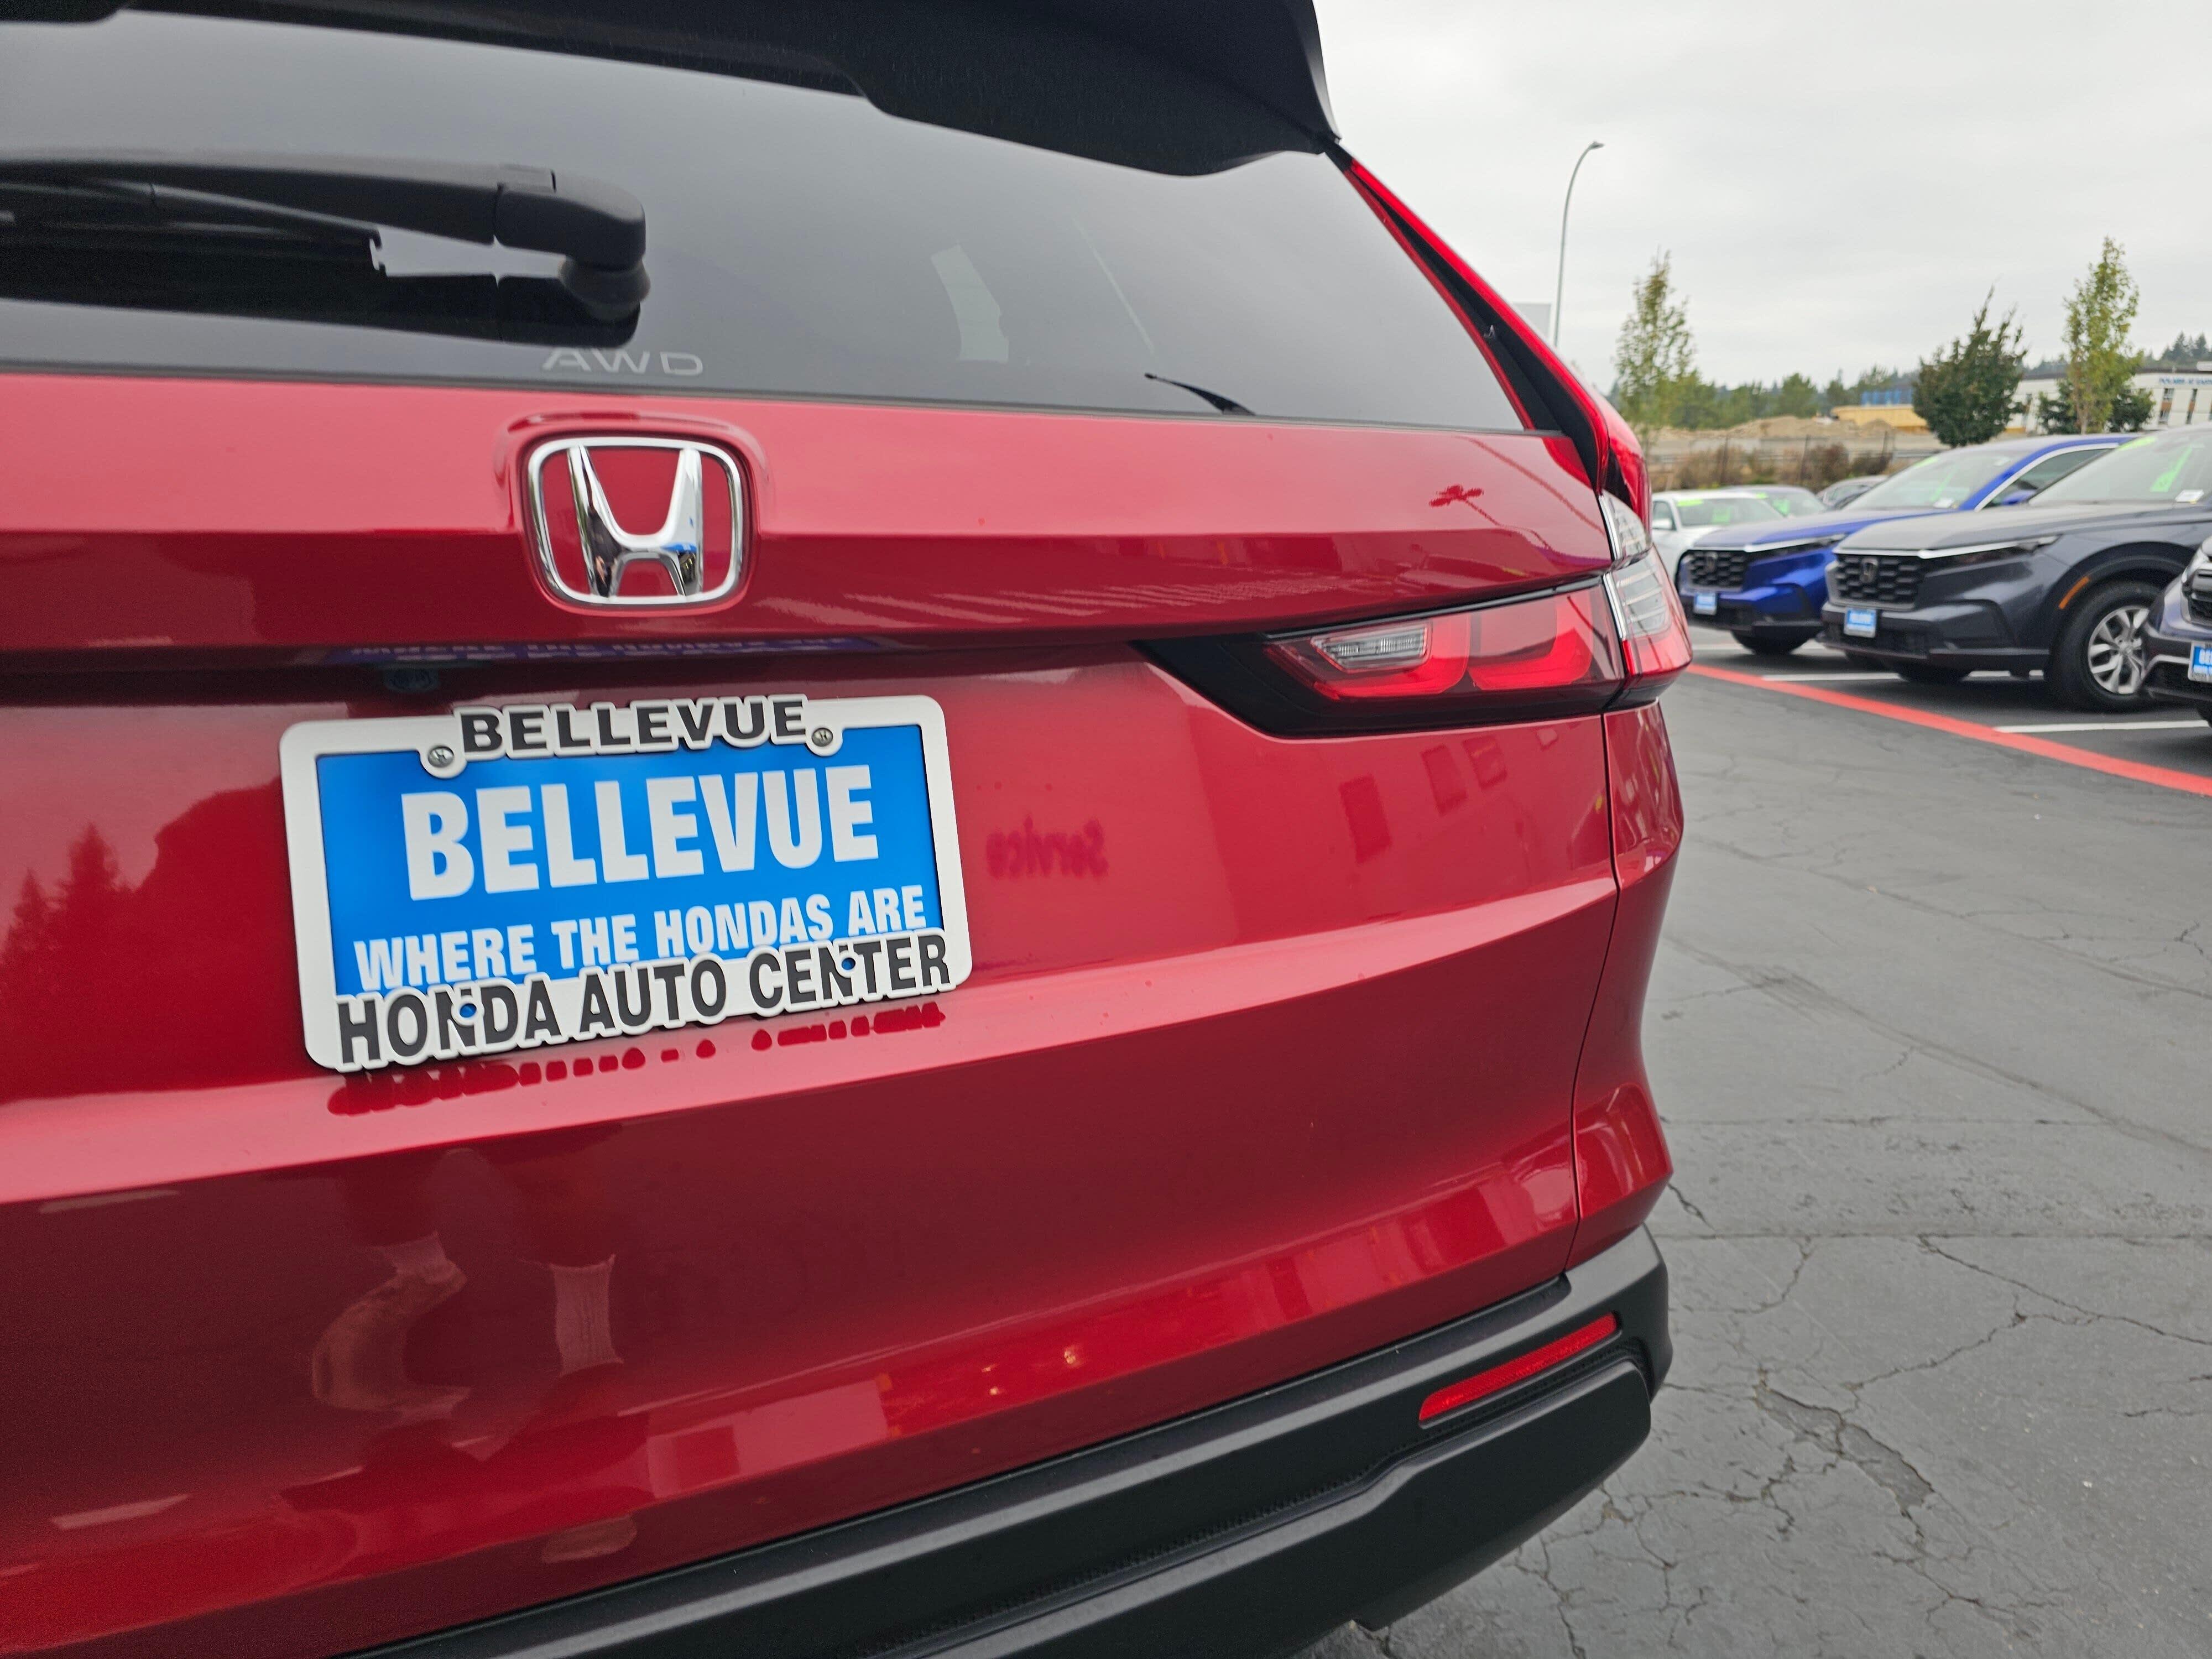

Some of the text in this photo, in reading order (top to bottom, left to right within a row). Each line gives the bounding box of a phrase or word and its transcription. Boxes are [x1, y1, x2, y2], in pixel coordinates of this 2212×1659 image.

[542, 348, 703, 375] AWD
[460, 700, 806, 753] BELLEVUE
[401, 765, 879, 900] BELLEVUE
[354, 885, 927, 992] WHERE THE HONDAS ARE
[337, 935, 951, 1064] HONDA AUTO CENTER
